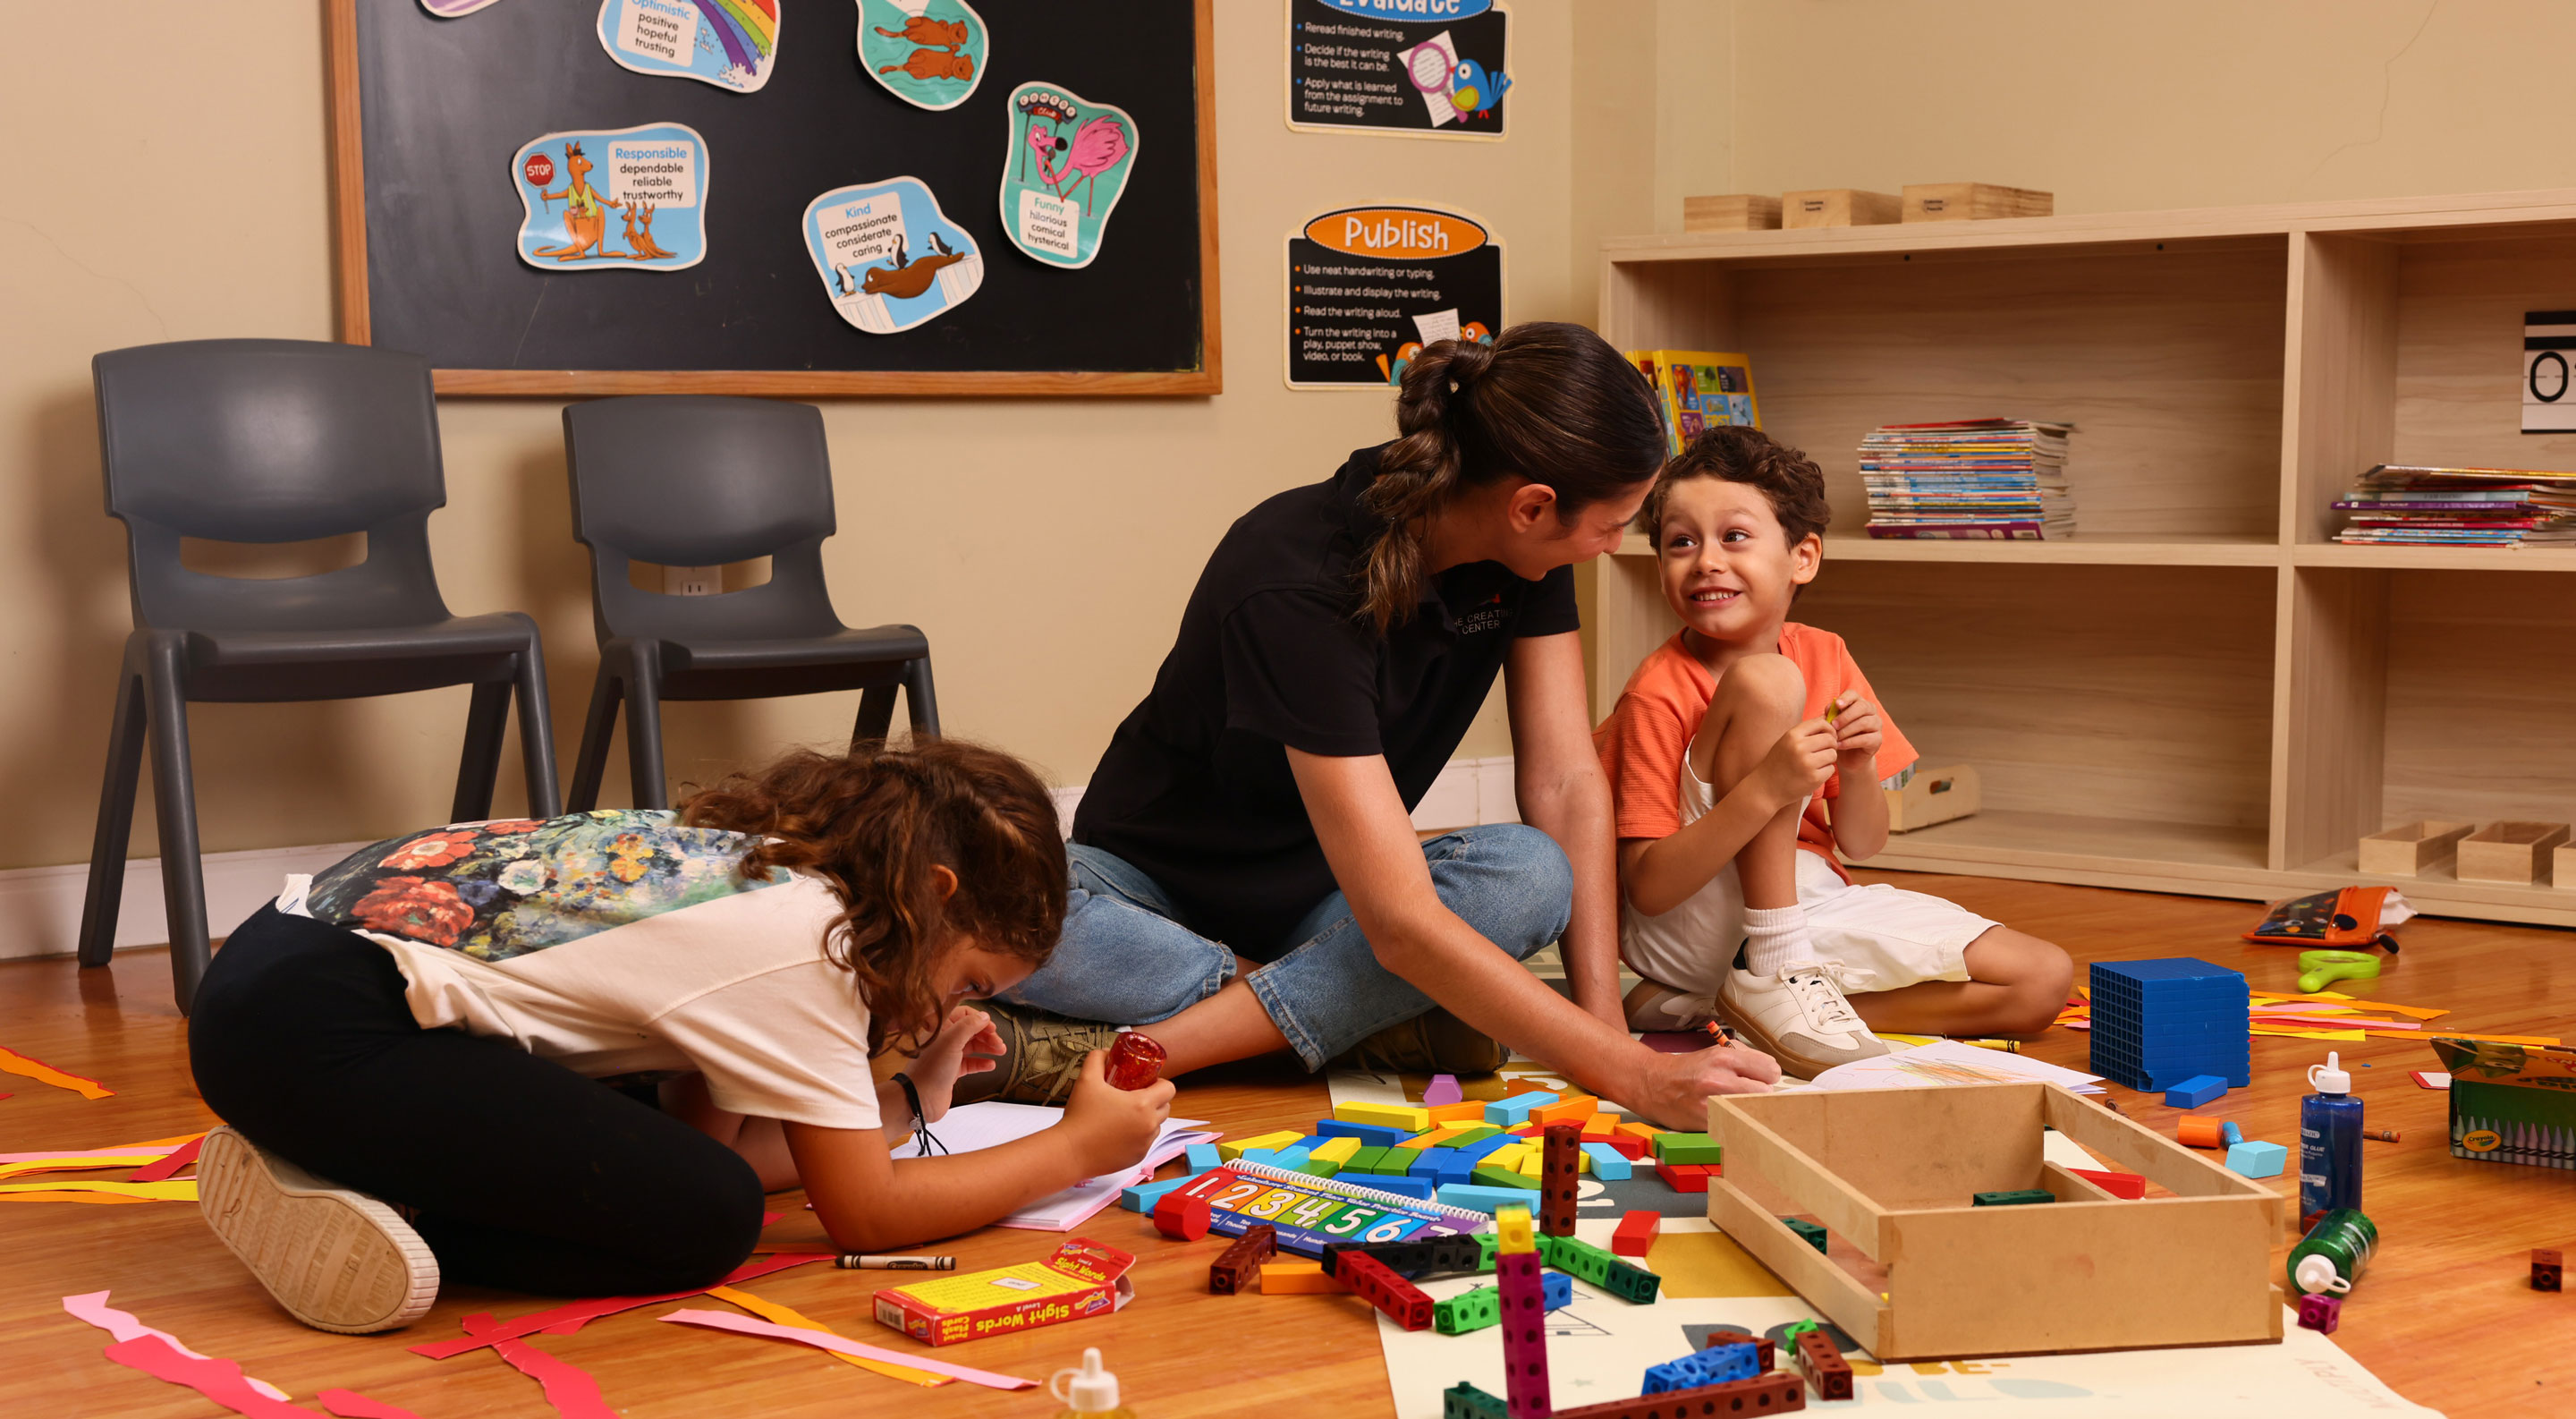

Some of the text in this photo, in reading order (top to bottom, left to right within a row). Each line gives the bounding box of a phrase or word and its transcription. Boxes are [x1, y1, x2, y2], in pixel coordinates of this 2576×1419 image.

[1340, 0, 1460, 14] uate
[638, 13, 679, 30] positive
[637, 24, 677, 43] hopeful
[1305, 21, 1405, 42] Reread finished writing.
[635, 38, 675, 58] trusting
[1305, 43, 1390, 62] Decide if the writing
[1304, 55, 1390, 72] is the best it can be.
[1304, 77, 1397, 93] Apply what is learned
[1304, 89, 1403, 106] from the assignment to
[1304, 101, 1365, 117] future writing.
[615, 148, 687, 161] Responsible
[527, 164, 551, 176] STOP
[620, 163, 683, 174] dependable
[632, 176, 673, 186] reliable
[623, 190, 683, 201] trustworthy
[845, 202, 871, 218] Kind
[1034, 198, 1065, 215] Funny
[825, 213, 897, 239] compassionate
[1030, 209, 1068, 227] hilarious
[836, 227, 892, 249] considerate
[1031, 223, 1065, 238] comical
[1344, 217, 1449, 251] Publish
[1028, 232, 1069, 251] hysterical
[852, 243, 883, 258] caring
[1303, 264, 1435, 280] Use neat handwriting or typing.
[1303, 285, 1442, 302] Illustrate and display the writing.
[1303, 305, 1402, 319] Read the writing aloud.
[1303, 326, 1397, 340] Turn the writing into a
[1325, 340, 1356, 351] puppet
[1331, 353, 1341, 361] or
[1454, 617, 1463, 627] HE
[1462, 620, 1501, 634] CENTER
[2468, 1134, 2494, 1143] Crayola
[1284, 1185, 1319, 1195] Student
[1320, 1191, 1344, 1201] Place
[1347, 1197, 1370, 1206] Value
[1371, 1203, 1409, 1215] Practice
[1409, 1211, 1437, 1221] Board
[1209, 1184, 1259, 1209] 2
[1250, 1192, 1296, 1216] 3
[1324, 1208, 1377, 1234] 5
[1365, 1219, 1412, 1242] 6
[1055, 1257, 1080, 1270] Sight
[1078, 1265, 1106, 1281] Words
[1022, 1302, 1041, 1312] Level
[942, 1315, 970, 1327] Cards
[976, 1303, 1070, 1333] Sight Words
[942, 1323, 969, 1336] Flash
[944, 1331, 968, 1342] Pocket
